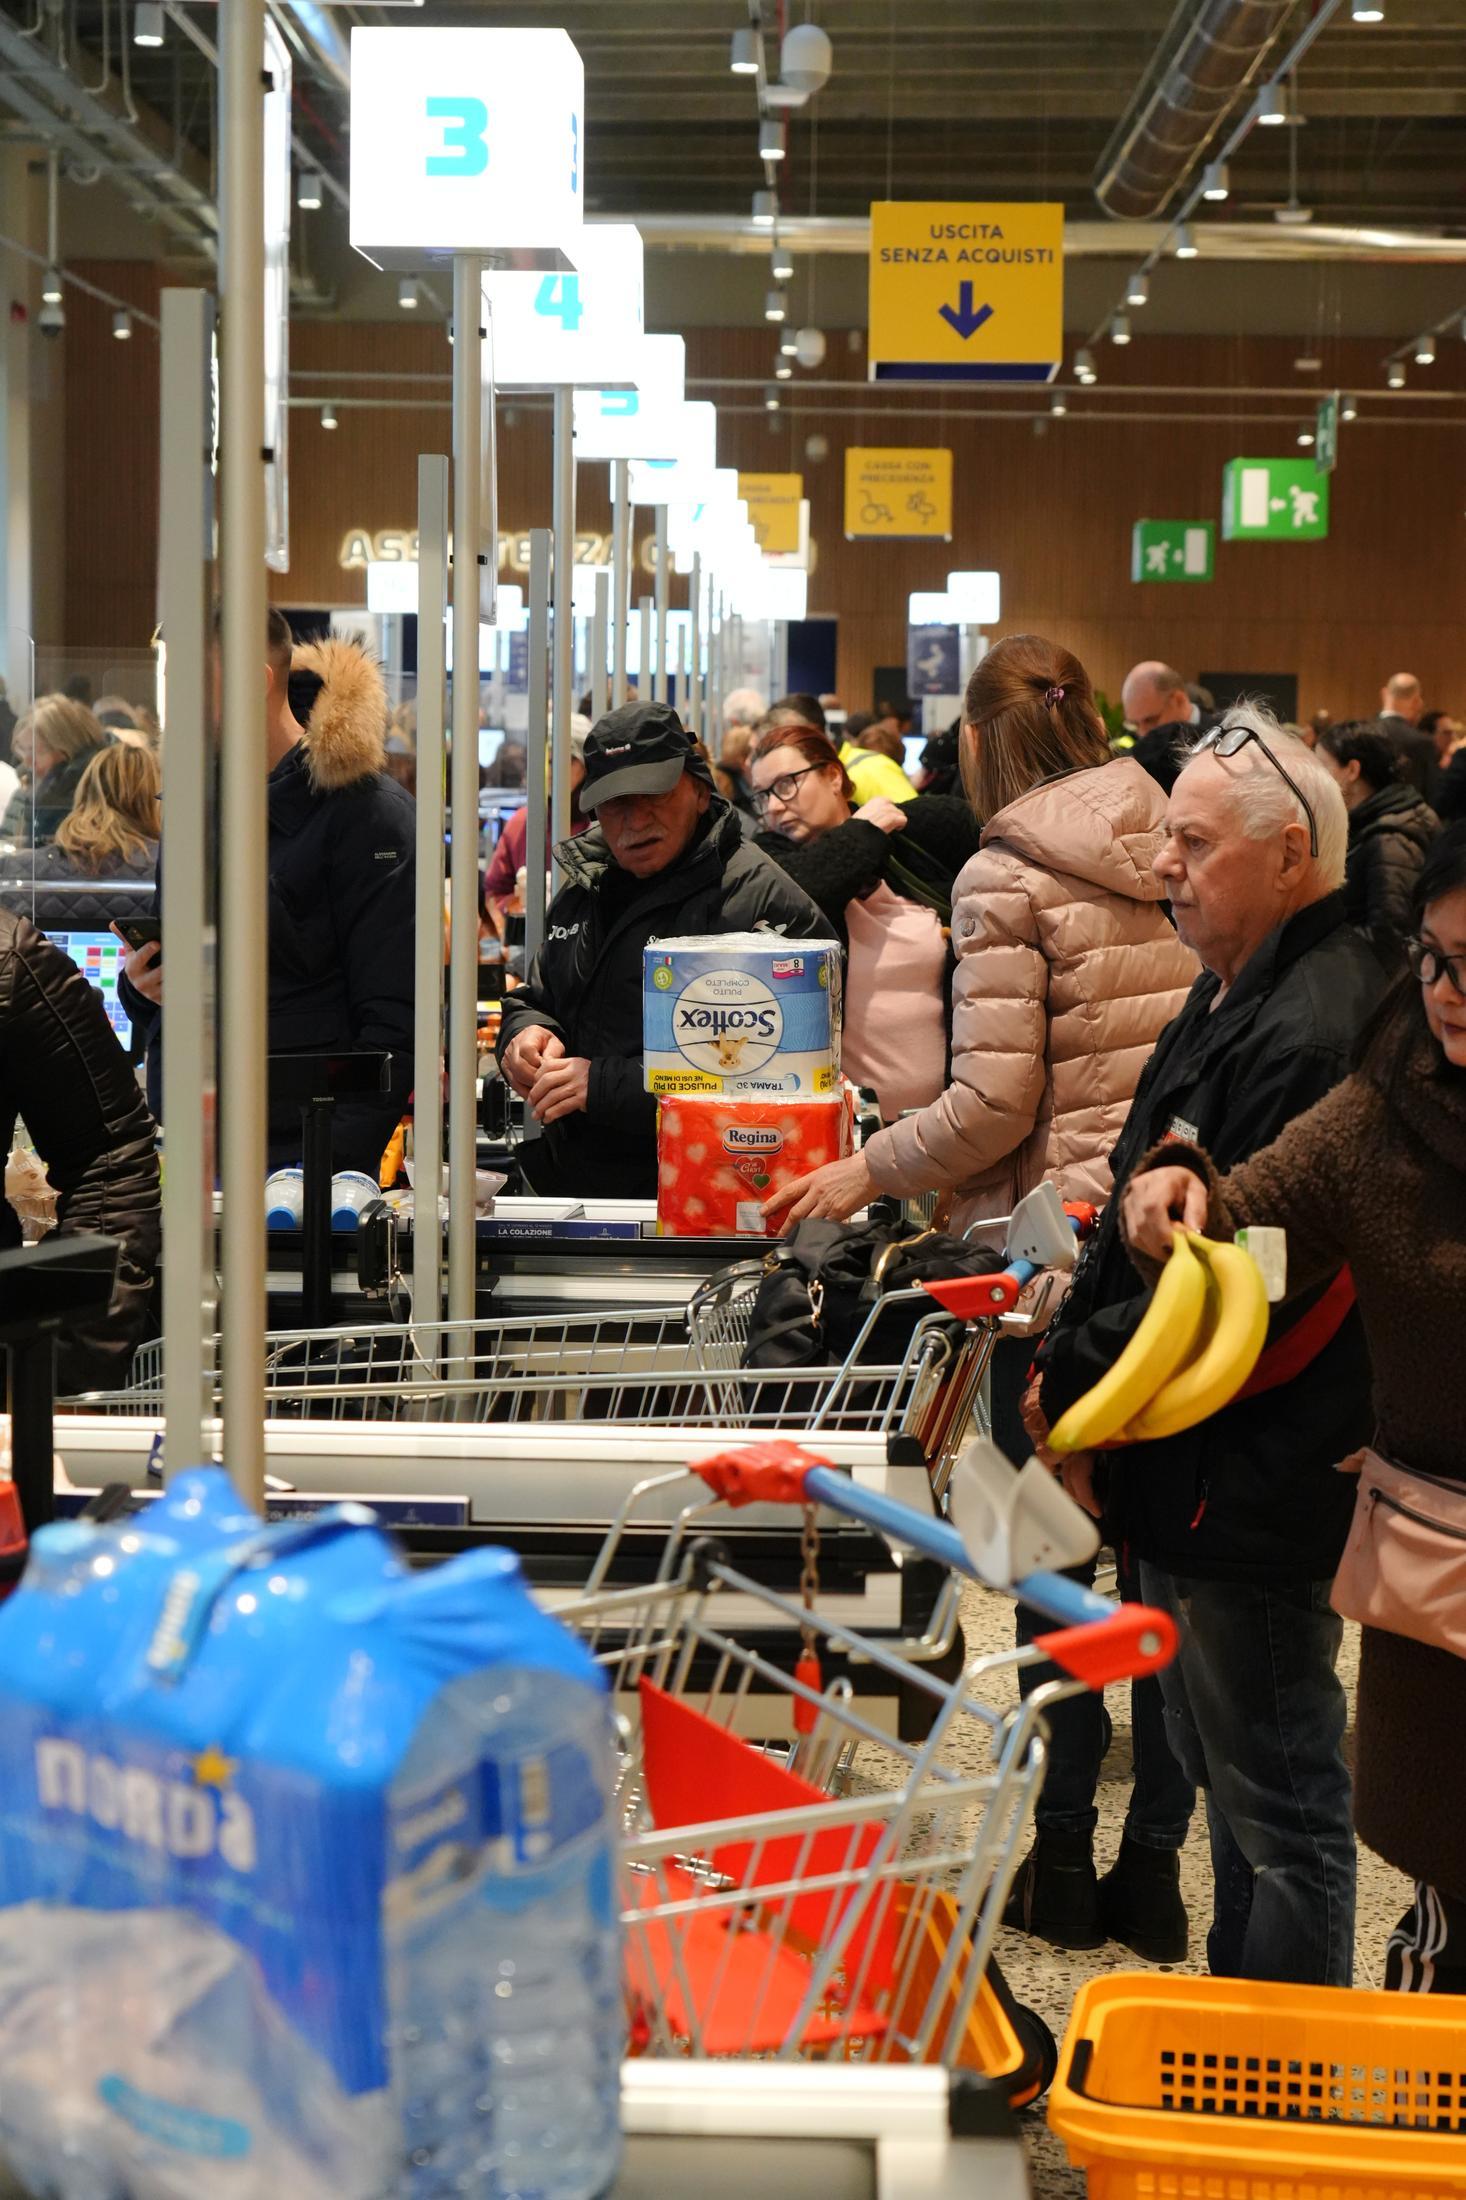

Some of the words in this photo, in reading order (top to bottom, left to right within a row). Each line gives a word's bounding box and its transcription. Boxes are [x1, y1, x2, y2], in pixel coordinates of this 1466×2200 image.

[426, 96, 490, 177] 3
[930, 224, 1004, 240] USCITA
[880, 248, 949, 264] SENZA
[956, 248, 1054, 264] ACQUISTI
[534, 274, 583, 331] 4
[793, 959, 800, 968] 8
[705, 979, 750, 988] COMPLETO
[713, 988, 742, 996] PULITO
[681, 1008, 776, 1037] Scottex
[667, 1082, 676, 1091] DI
[678, 1082, 717, 1091] PULISCE
[752, 1082, 784, 1091] TRAMA
[729, 1130, 777, 1146] Regina
